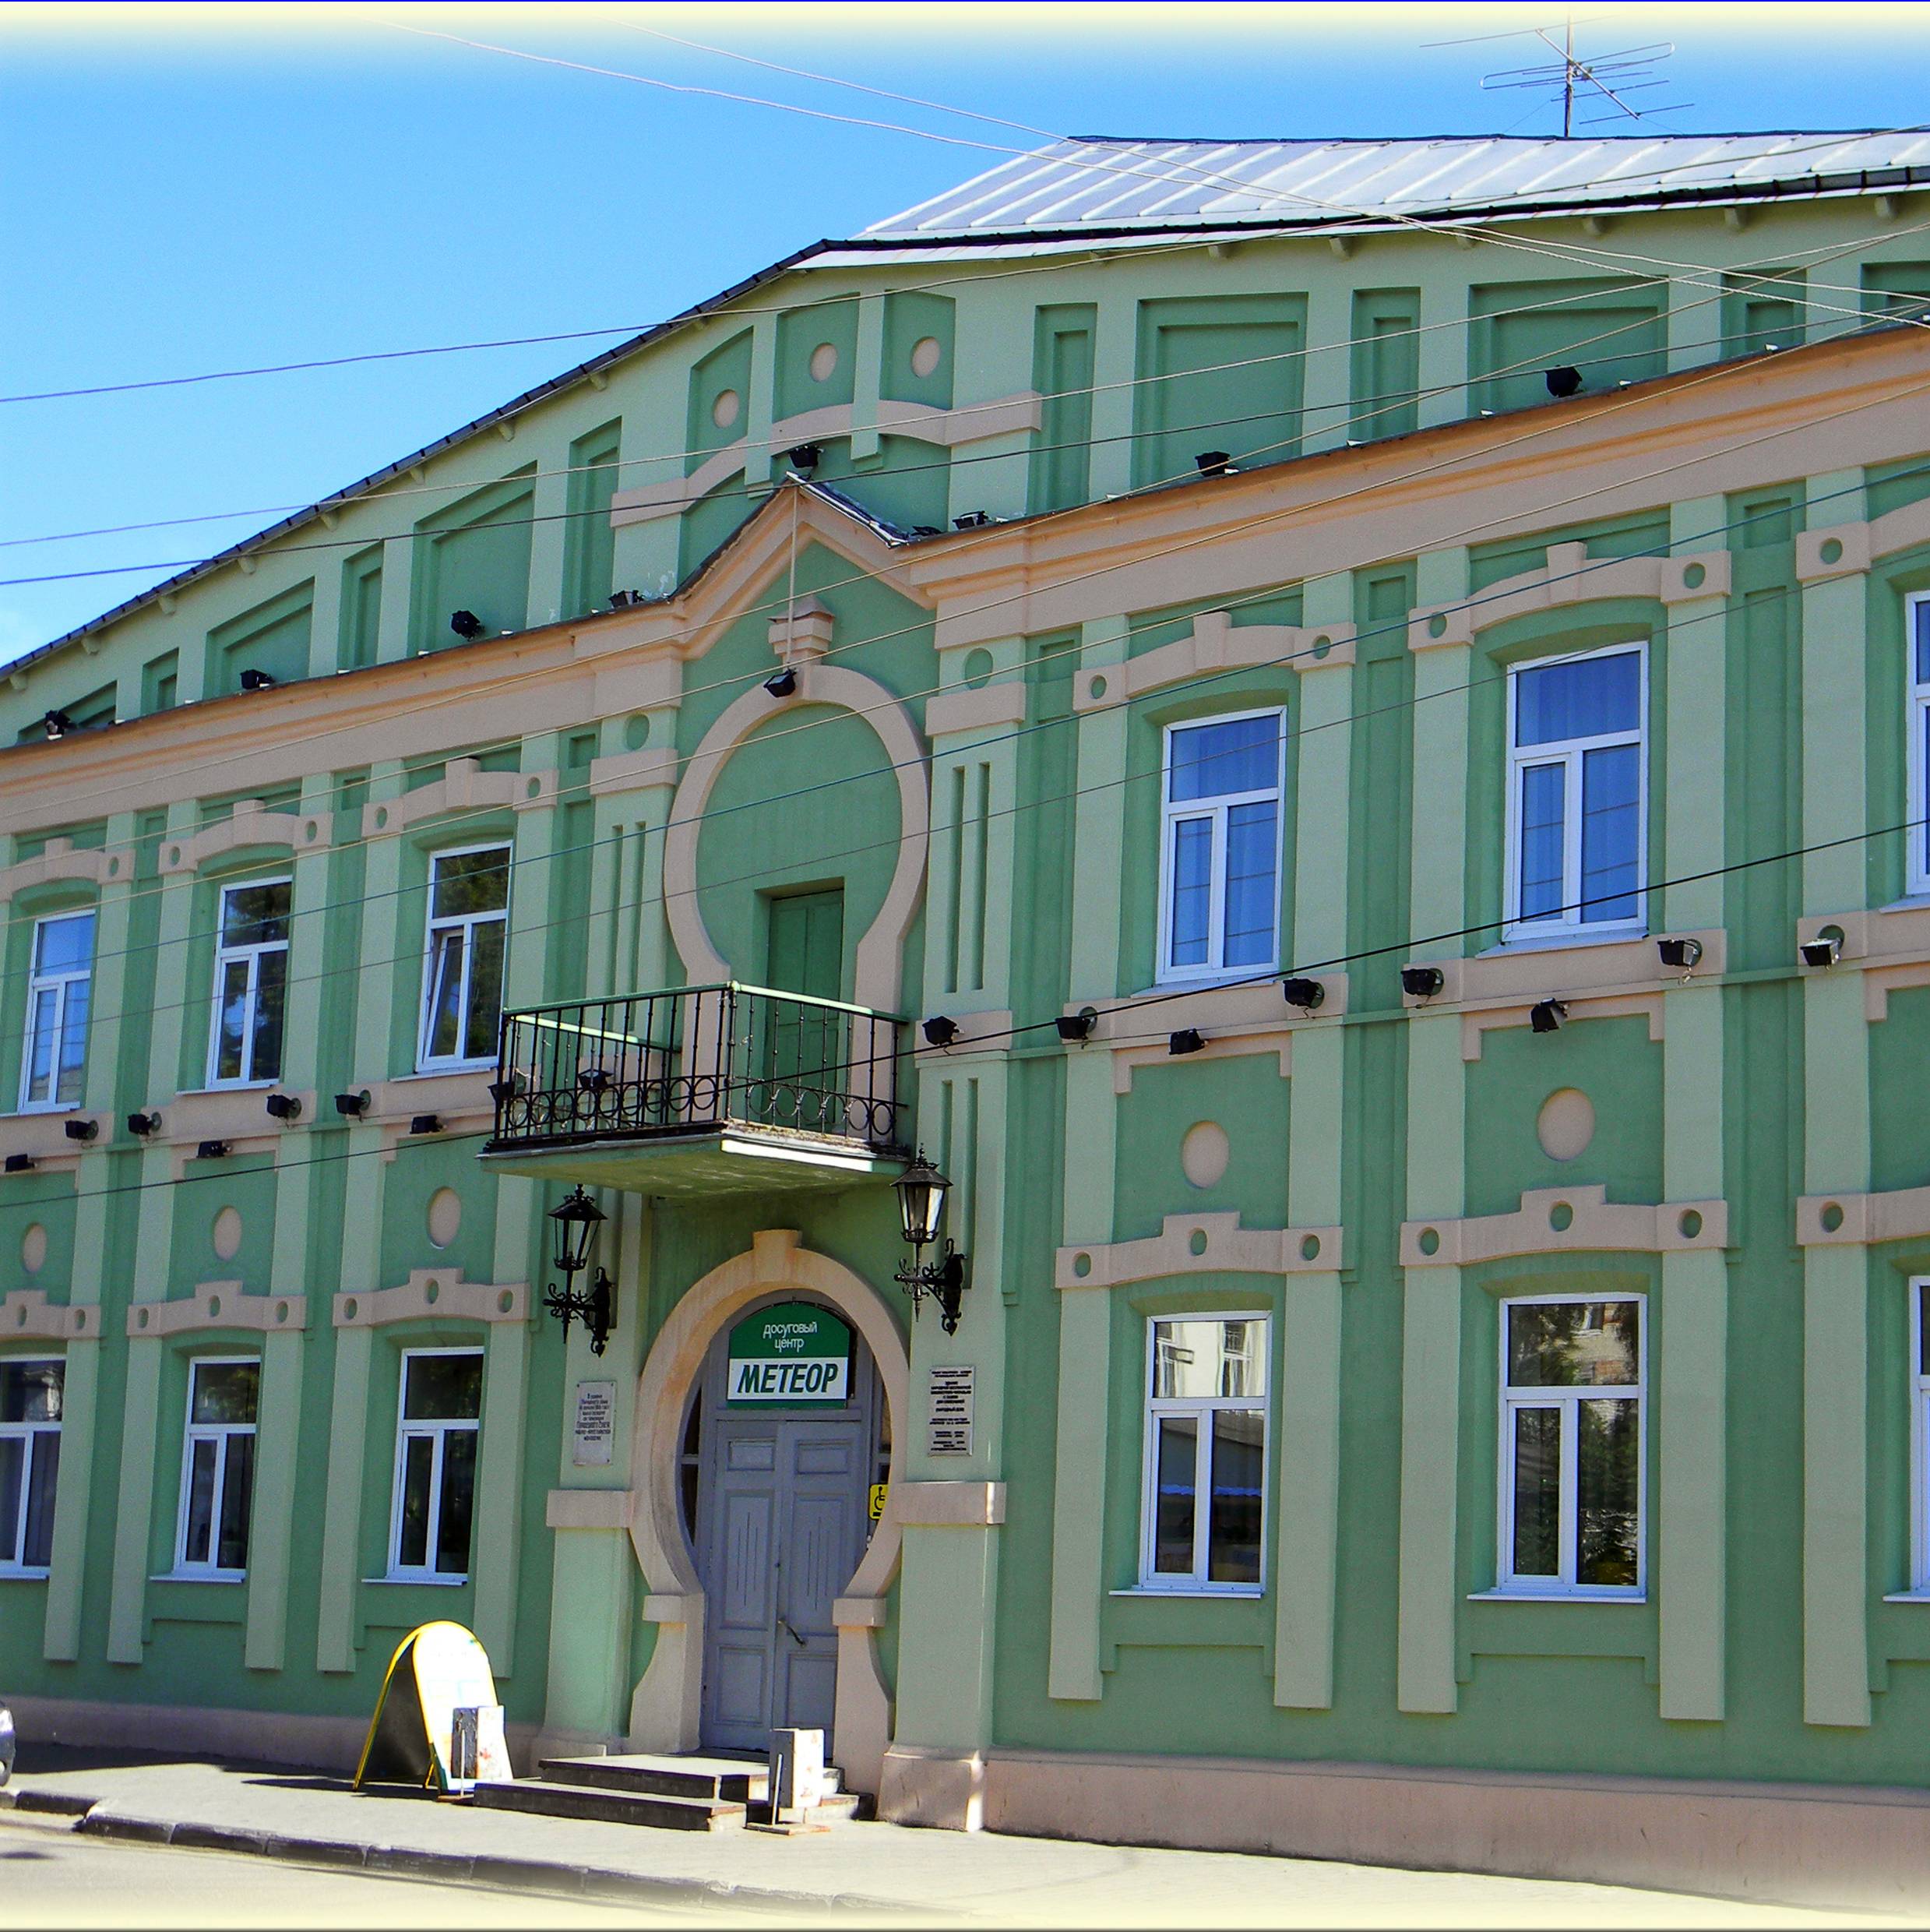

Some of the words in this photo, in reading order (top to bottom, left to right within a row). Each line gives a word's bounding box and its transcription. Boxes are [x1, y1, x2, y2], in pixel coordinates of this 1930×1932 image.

[762, 1321, 818, 1339] досуговый
[774, 1338, 805, 1352] центр
[737, 1363, 839, 1393] МЕТЕОР
